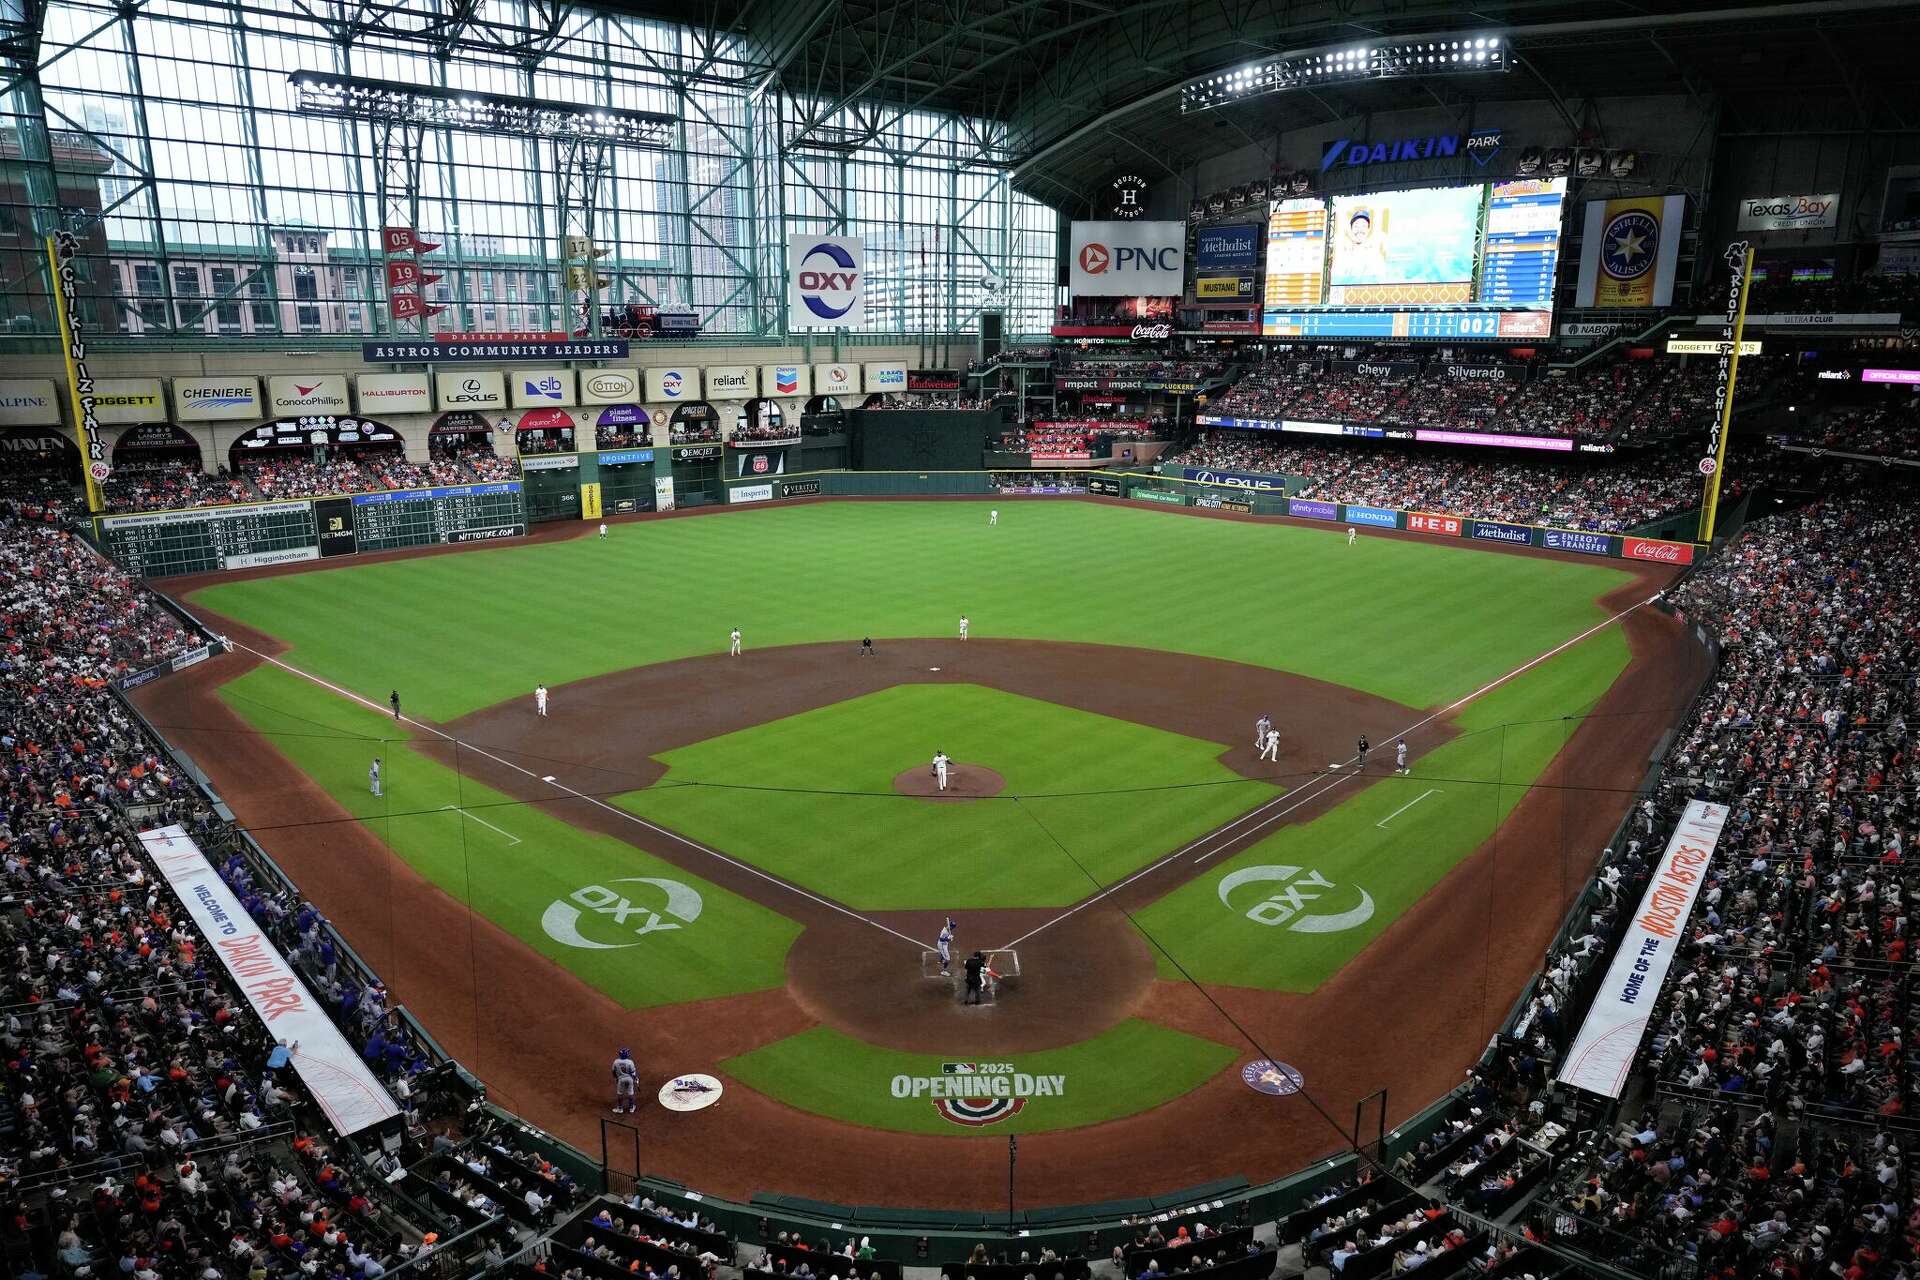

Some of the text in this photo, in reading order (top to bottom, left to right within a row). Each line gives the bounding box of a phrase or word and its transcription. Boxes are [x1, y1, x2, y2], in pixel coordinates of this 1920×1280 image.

[1349, 135, 1501, 166] DAIKIN PARK
[1113, 175, 1147, 188] HOUSTON
[1121, 190, 1137, 204] H
[1113, 206, 1144, 217] ASTROS
[1747, 199, 1832, 218] Texas Bay
[1609, 217, 1655, 238] ESTRELLA
[391, 233, 409, 246] 05
[1202, 238, 1252, 253] Methodist
[571, 241, 585, 252] 17
[1113, 247, 1178, 271] PNC
[395, 267, 412, 279] 19
[1609, 259, 1648, 274] JALISCO
[799, 272, 858, 290] OXY
[1203, 282, 1252, 292] MUSTANG CAT
[398, 298, 415, 311] 21
[1726, 274, 1742, 322] ROOT
[61, 266, 86, 360] CHIKIN
[1131, 324, 1172, 339] Coca-Cola
[1460, 317, 1495, 334] 0 0 2
[1503, 322, 1537, 333] reliant
[1580, 326, 1619, 335] NABOR
[1723, 328, 1733, 339] 4
[376, 344, 619, 357] ASTROS COMMUNITY LEADERS
[1357, 364, 1391, 376] Chevy
[1447, 366, 1505, 379] Silverado
[1818, 371, 1843, 379] reliant
[540, 376, 562, 391] slb
[593, 381, 629, 393] COTTON
[713, 374, 746, 387] reliant
[909, 378, 960, 389] Budweiser
[1065, 380, 1098, 389] impact
[1109, 380, 1142, 389] impact
[183, 387, 252, 399] CHENIERE
[362, 389, 427, 397] HALLIBURTON
[446, 393, 498, 403] LEXUS
[96, 396, 156, 406] OGGETT
[276, 396, 344, 407] ConocoPhillips
[609, 408, 632, 417] planet
[681, 406, 697, 415] SPACE
[528, 419, 551, 427] equinor
[612, 414, 637, 422] fitness
[1707, 386, 1727, 455] CHIKIN
[81, 398, 104, 460] FAIR
[1, 437, 65, 451] MAVEN
[1580, 444, 1605, 452] reliant
[688, 448, 714, 457] EMCJET
[755, 461, 765, 469] 66
[790, 483, 818, 491] VERITEX
[1215, 476, 1272, 489] LEXUS
[561, 494, 575, 502] 366
[740, 487, 770, 499] Insperity
[1195, 498, 1211, 508] SPACE
[1211, 499, 1222, 509] CITY
[1292, 503, 1335, 515] xfinity mobile
[1356, 511, 1395, 523] HONDA
[321, 530, 353, 540] BETMGM
[458, 528, 514, 541] NITTOTIRE.COM
[1477, 527, 1526, 542] Methodist
[1561, 533, 1599, 544] ENERGY
[214, 522, 225, 569] NATIONAL
[1561, 541, 1608, 553] TRANSFER
[1633, 542, 1681, 560] Coca-Cola
[254, 551, 309, 565] Higginbotham
[122, 671, 155, 689] AmegyBank
[1246, 869, 1336, 926] OXY
[1636, 844, 1708, 938] HOUSTON ASTROS
[192, 884, 238, 936] WELCOME TO
[569, 885, 683, 935] OXY
[1620, 937, 1660, 1004] HOME OF THE
[217, 934, 309, 1022] DAIKIN PARK
[979, 1063, 1015, 1074] 2025
[890, 1073, 1067, 1098] OPENING DAY
